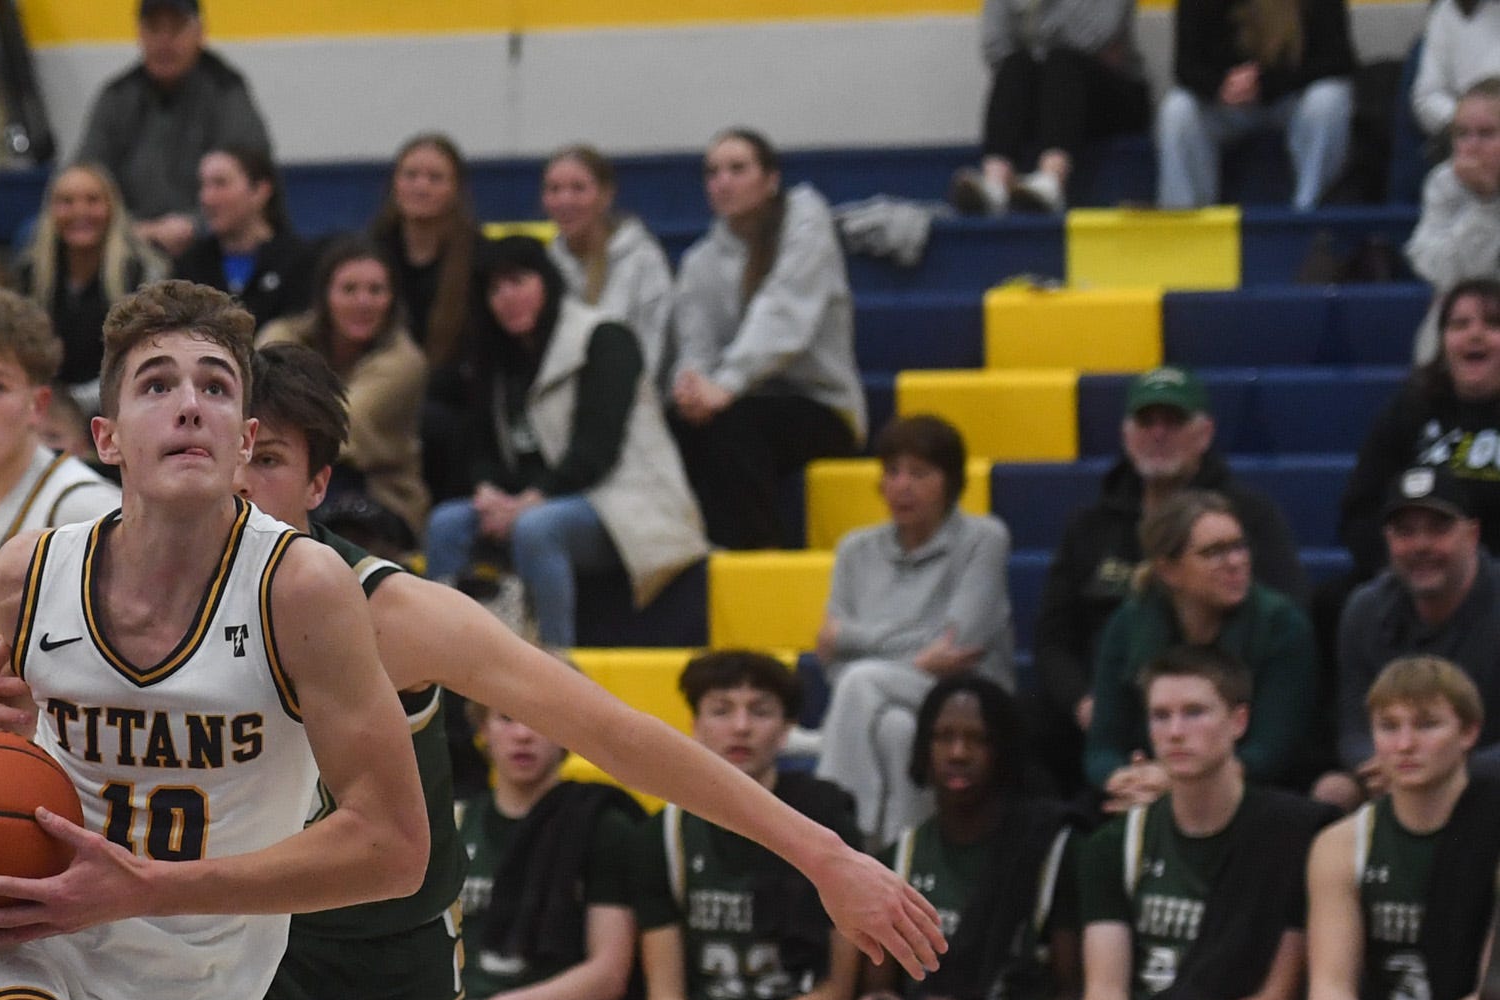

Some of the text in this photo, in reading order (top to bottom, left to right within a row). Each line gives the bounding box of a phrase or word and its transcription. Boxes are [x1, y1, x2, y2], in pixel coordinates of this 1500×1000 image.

[224, 623, 250, 658] T
[46, 697, 264, 770] TITANS
[99, 779, 211, 863] 10
